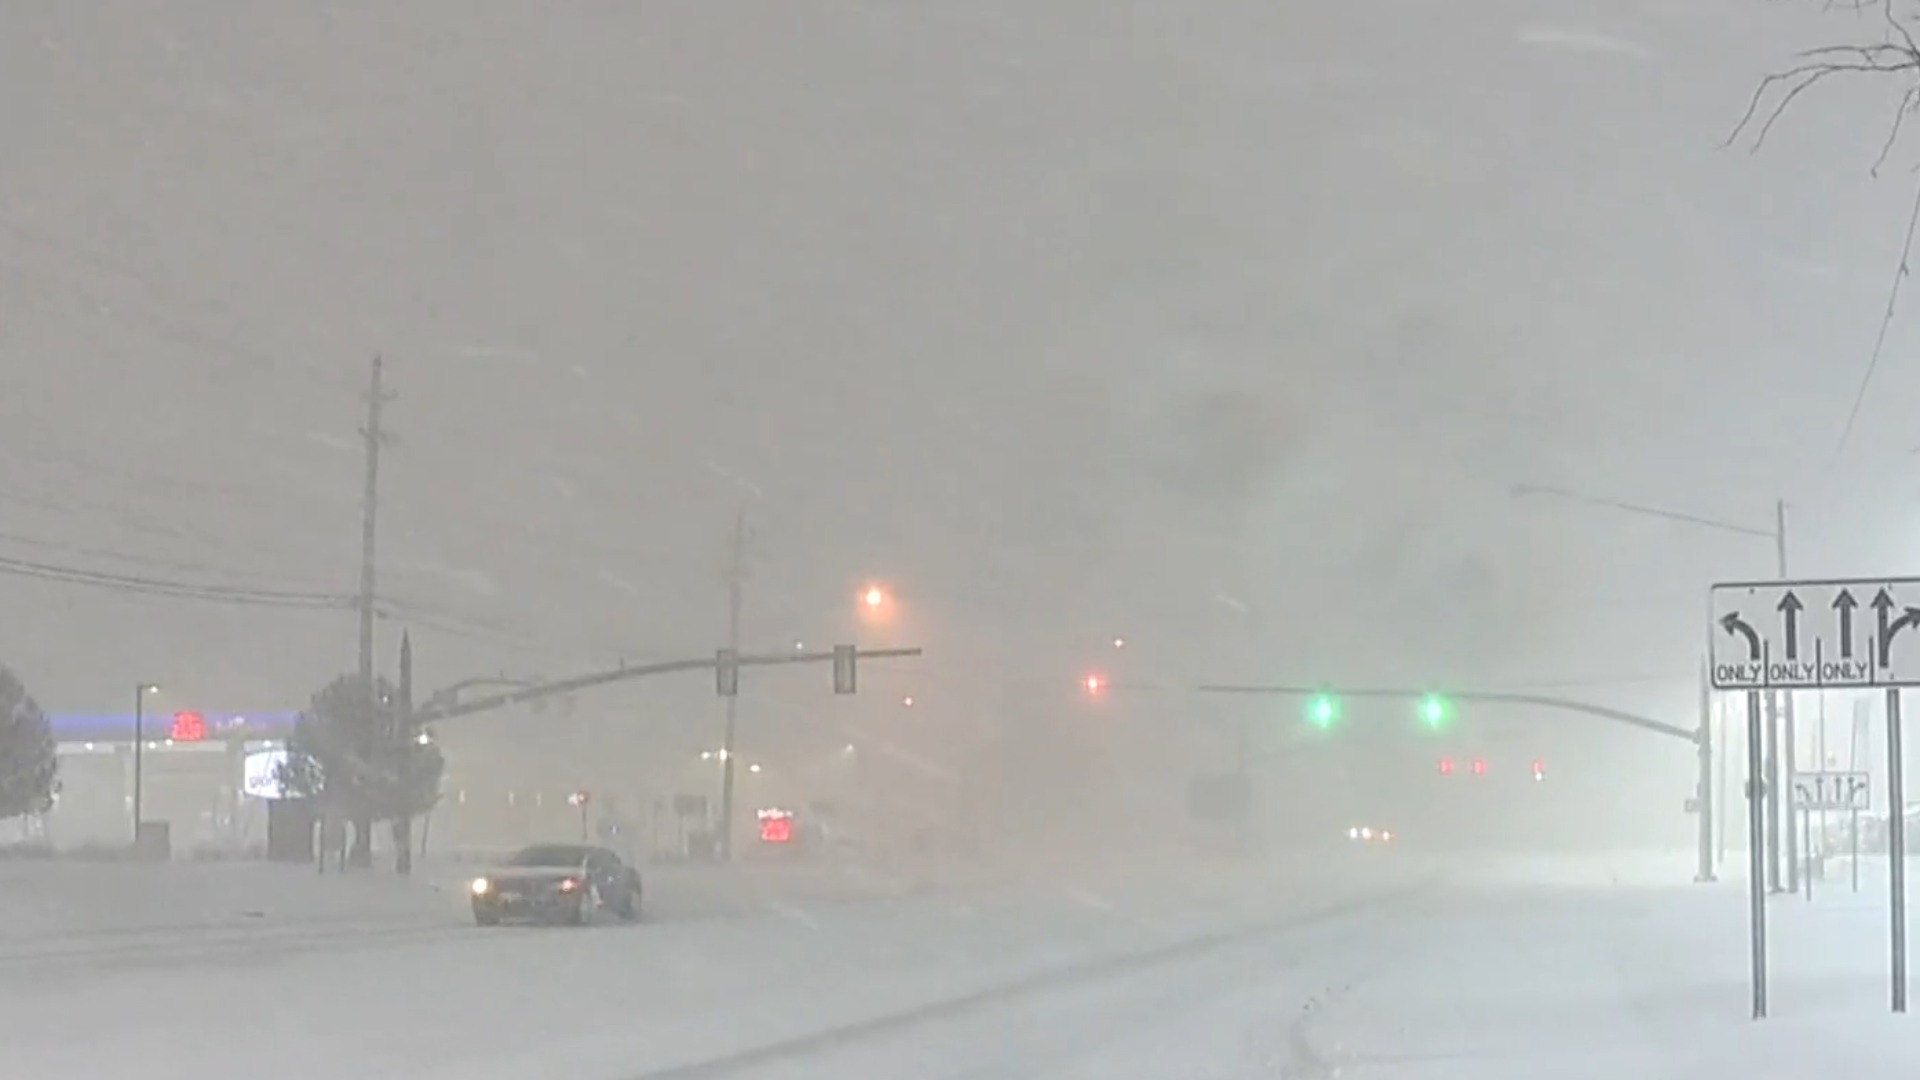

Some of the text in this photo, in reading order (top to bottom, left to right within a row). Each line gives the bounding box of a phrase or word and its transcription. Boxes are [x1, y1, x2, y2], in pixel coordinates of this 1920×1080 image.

[1717, 661, 1868, 682] ONLY ONLY ONLY
